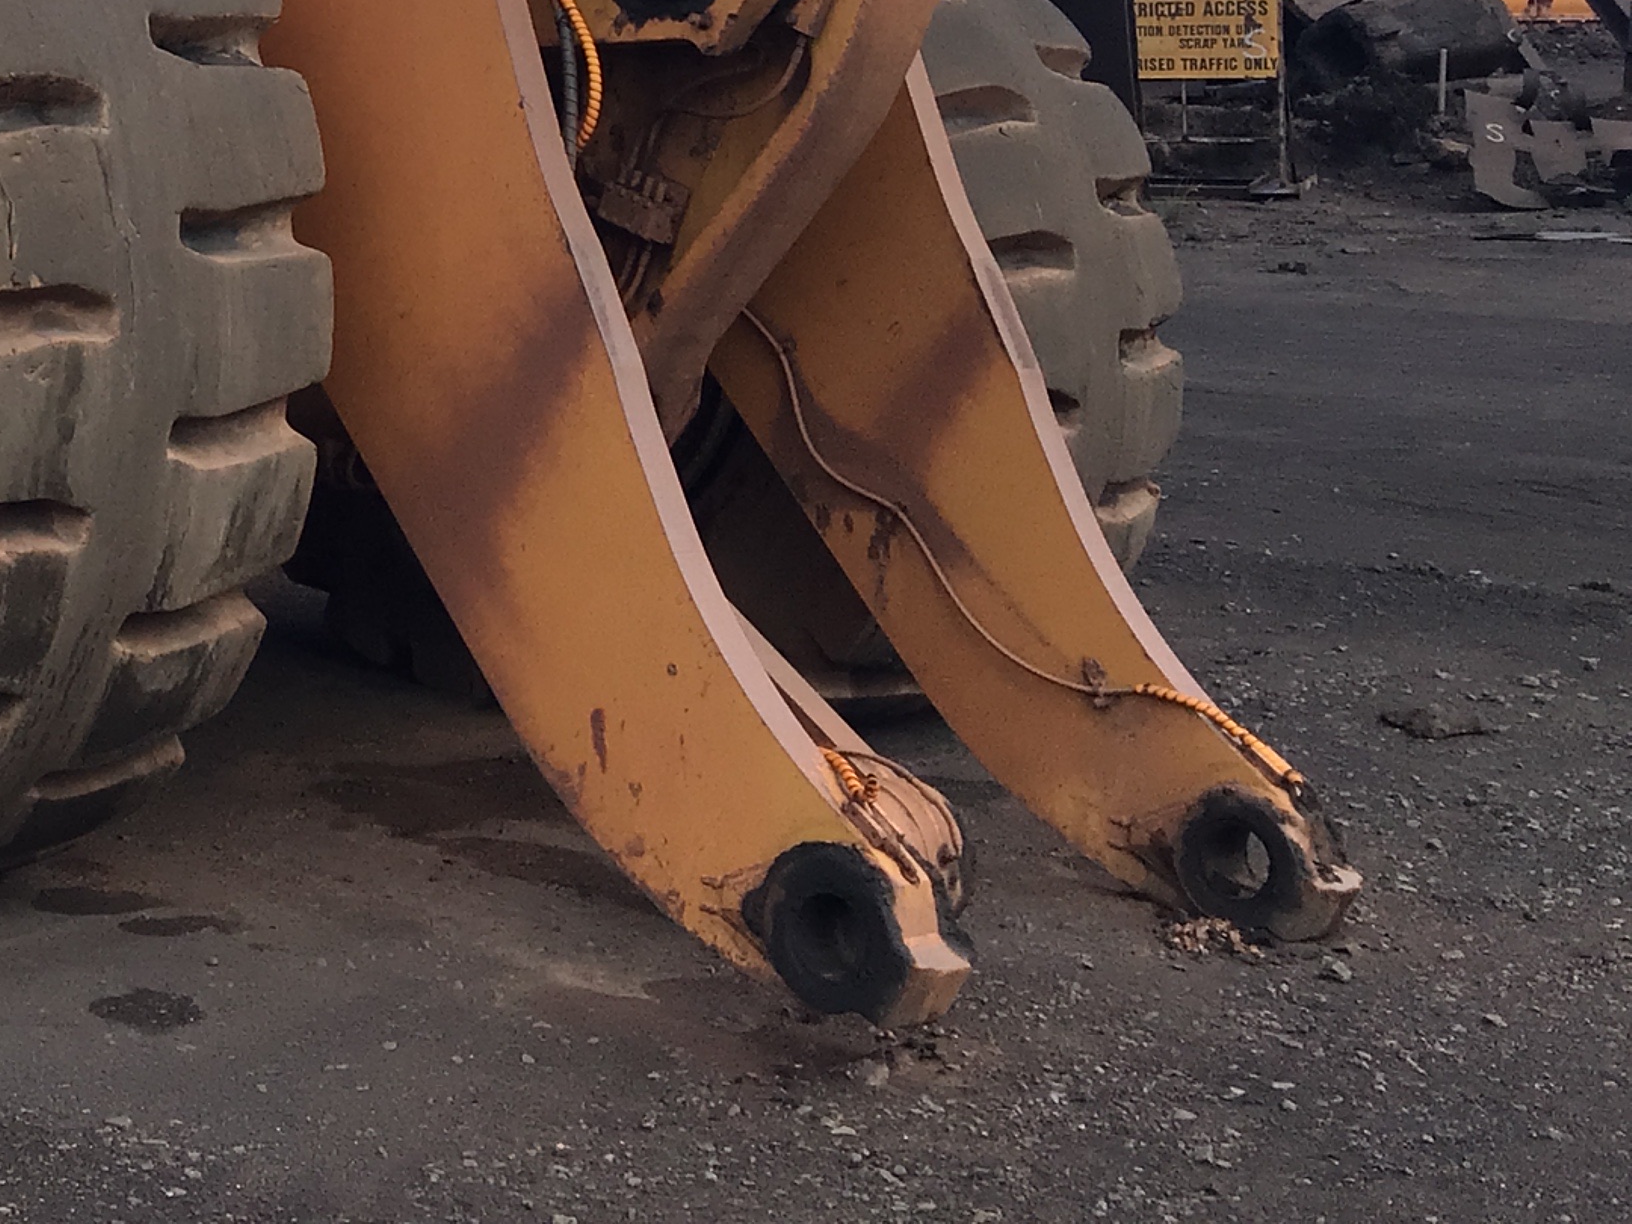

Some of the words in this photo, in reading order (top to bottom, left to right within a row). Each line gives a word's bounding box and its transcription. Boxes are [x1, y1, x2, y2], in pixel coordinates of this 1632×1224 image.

[1133, 1, 1195, 17] RICTED
[1203, 0, 1268, 16] ACCESS
[1168, 24, 1230, 36] DETECTION
[1179, 38, 1217, 49] SCRAP
[1180, 57, 1238, 71] TRAFFIC
[1244, 57, 1278, 71] ONLY
